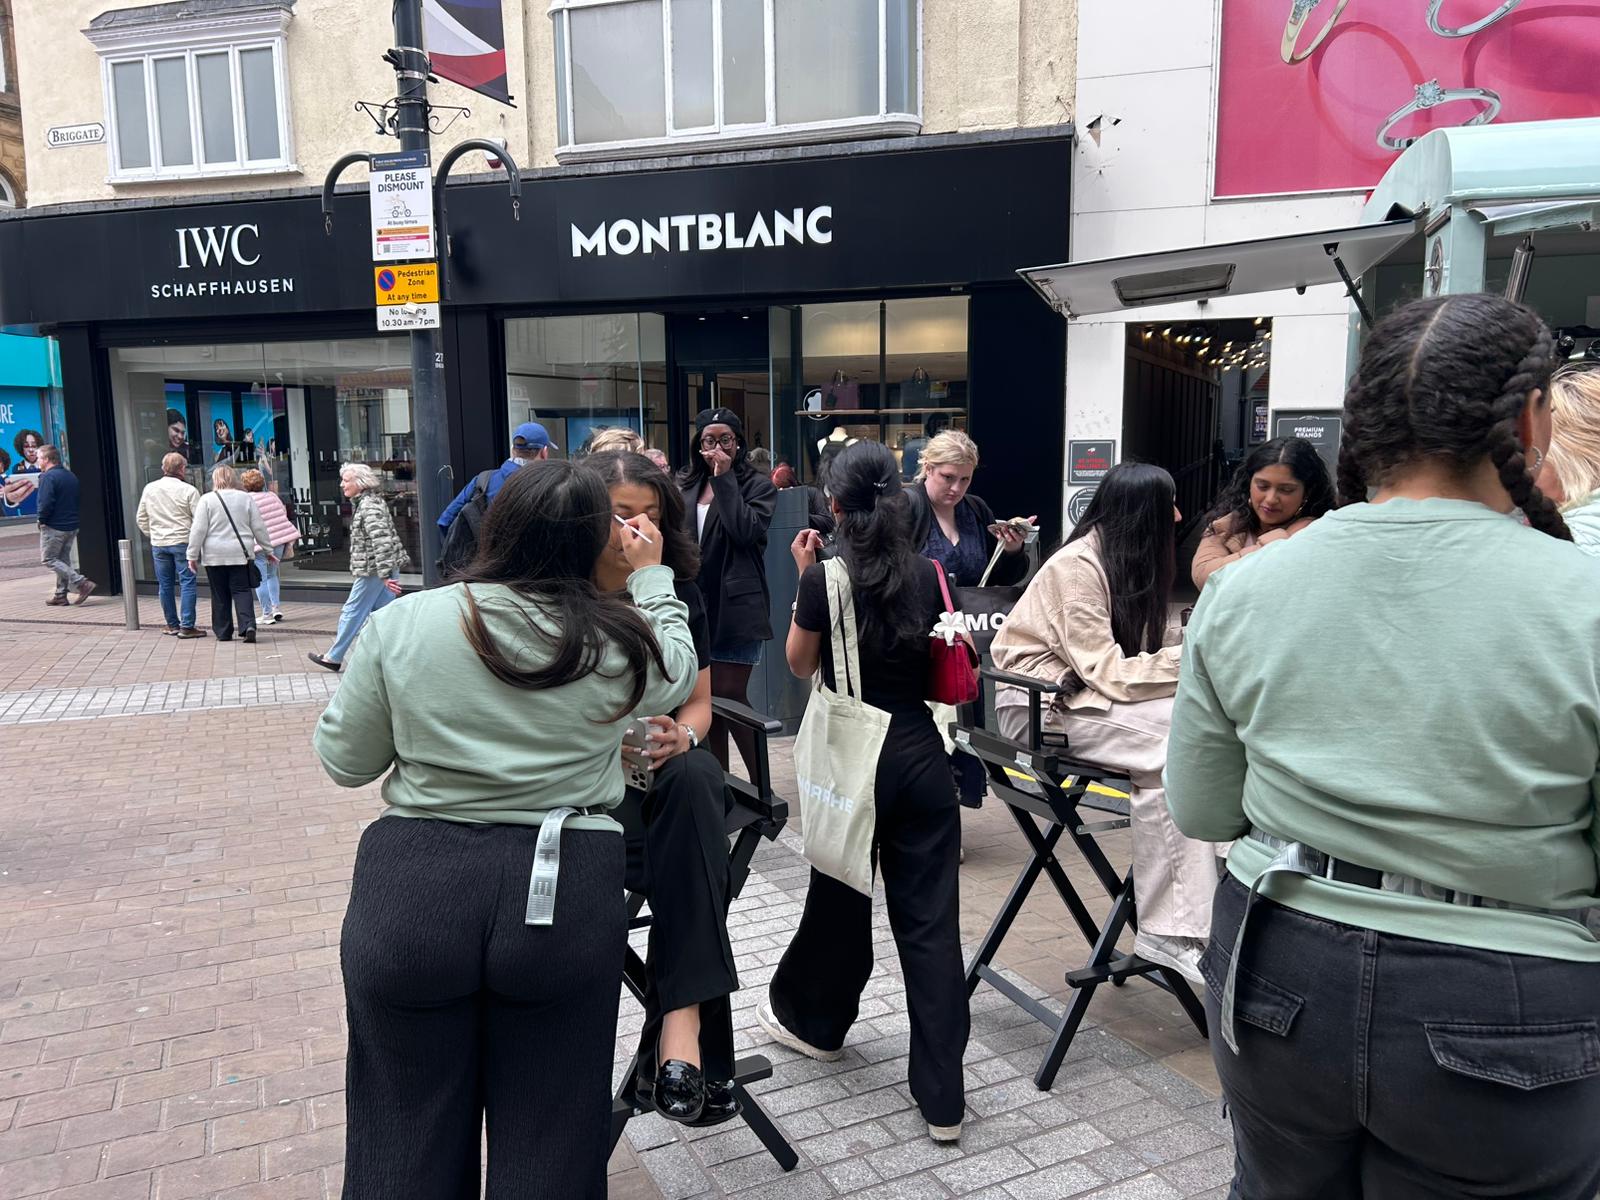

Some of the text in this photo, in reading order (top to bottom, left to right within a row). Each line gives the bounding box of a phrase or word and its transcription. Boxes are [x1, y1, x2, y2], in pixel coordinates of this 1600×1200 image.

[385, 172, 416, 182] PLEASE
[378, 181, 424, 192] DISMOUNT
[571, 205, 832, 257] MONTBLANC
[175, 223, 261, 269] IWC
[398, 269, 435, 277] Pedestrian
[151, 278, 294, 298] SCHAFFHAUSEN
[397, 294, 410, 302] any
[411, 292, 428, 300] time
[389, 308, 400, 316] No
